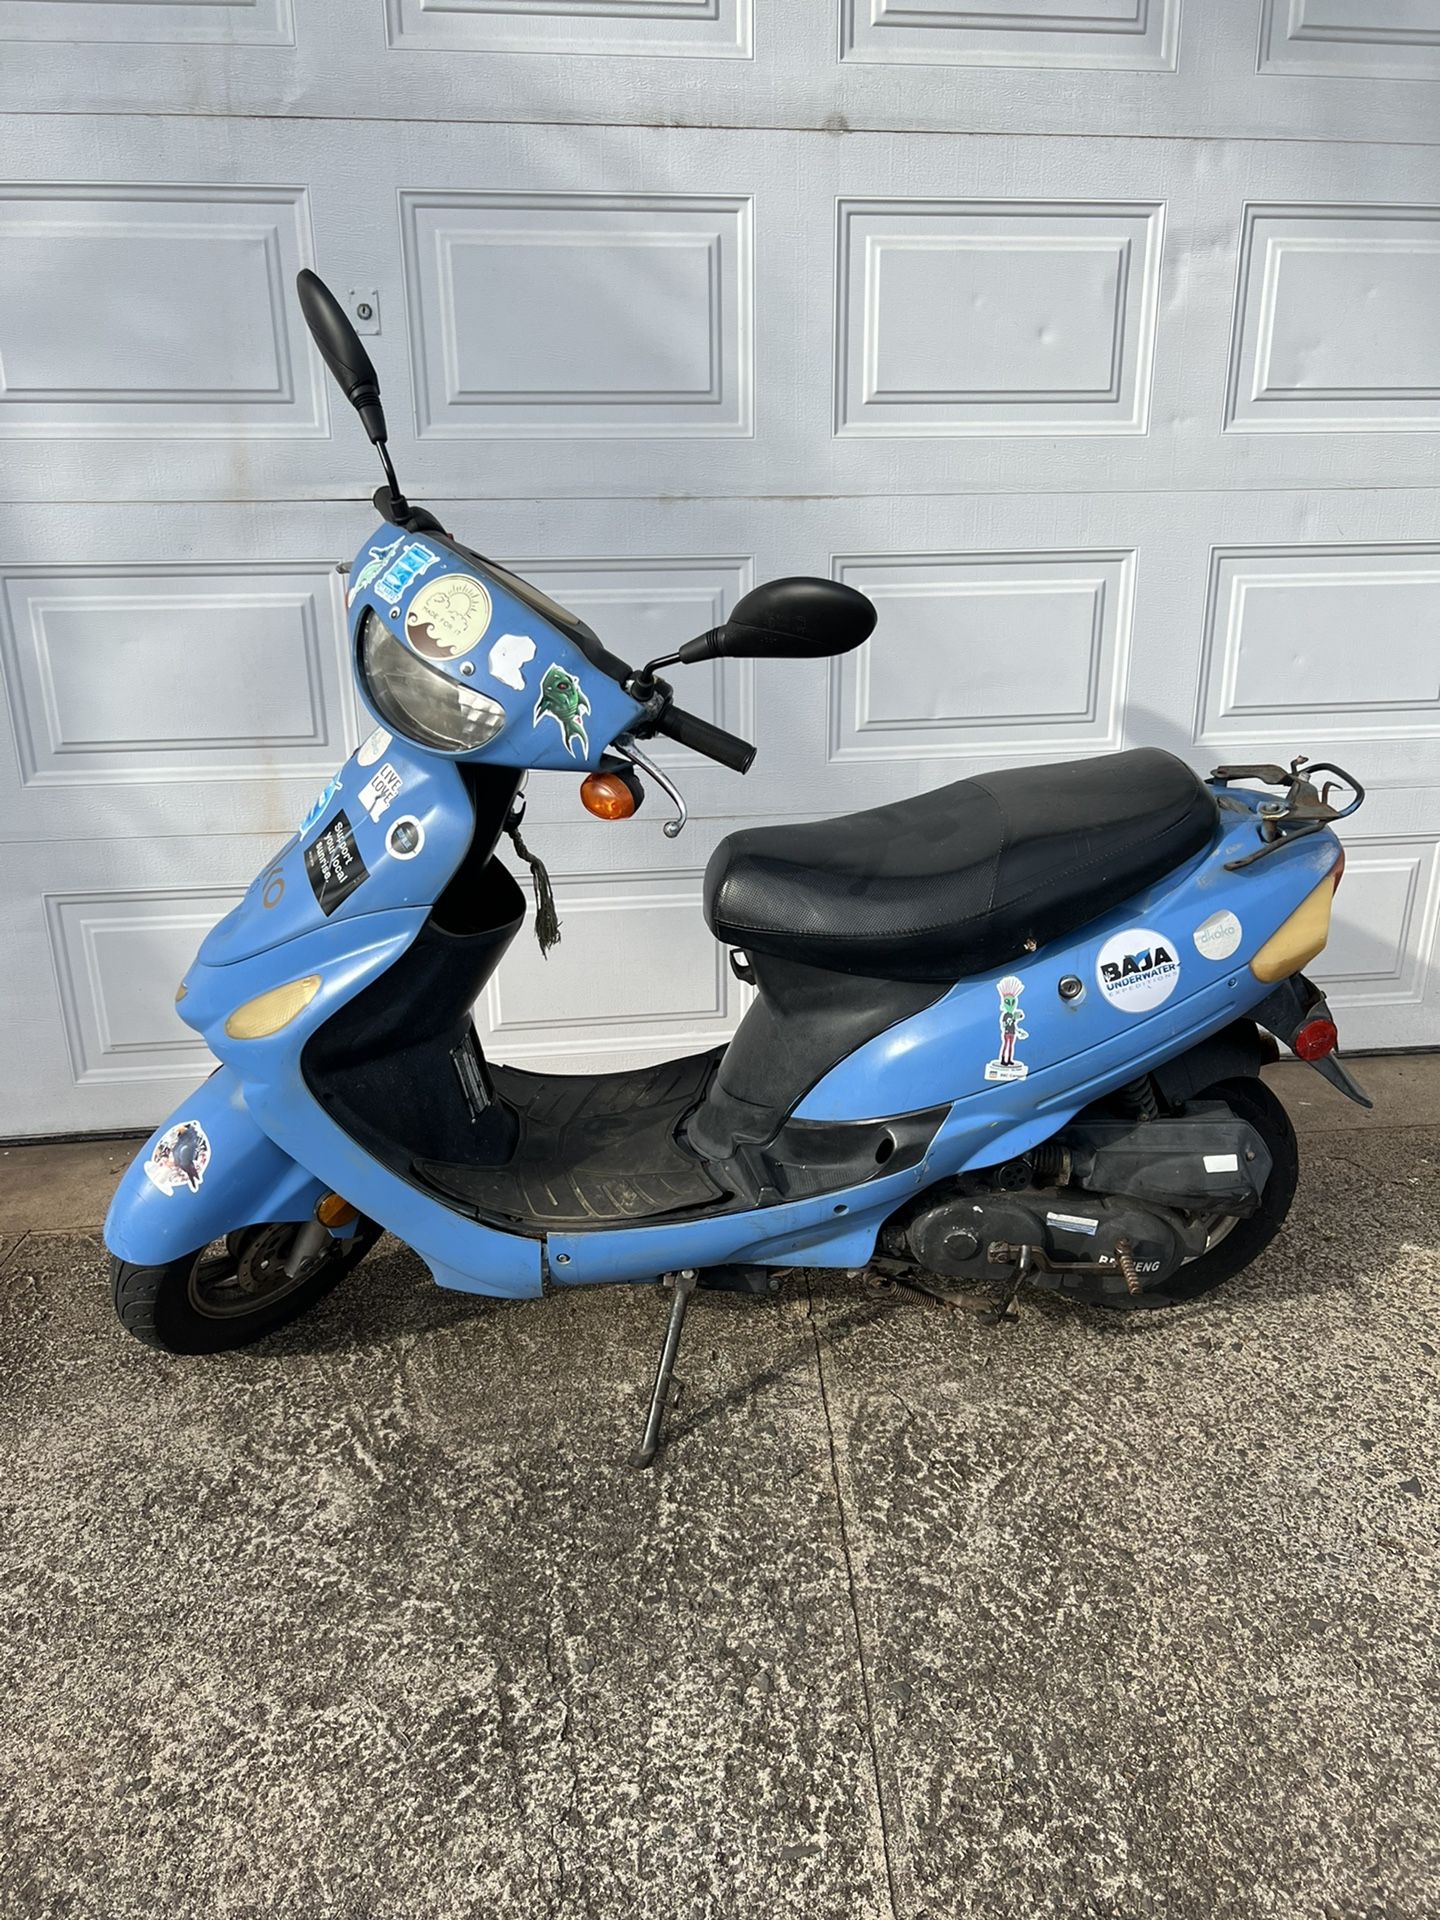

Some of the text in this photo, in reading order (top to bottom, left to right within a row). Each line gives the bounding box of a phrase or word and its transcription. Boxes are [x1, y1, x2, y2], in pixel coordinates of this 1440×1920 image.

[315, 841, 332, 883] sunrise.
[323, 831, 349, 884] your local
[334, 821, 354, 866] Support
[1100, 947, 1173, 983] BAJA
[1106, 963, 1176, 991] UNDERWATER
[1108, 971, 1178, 997] EXPEDITIONS
